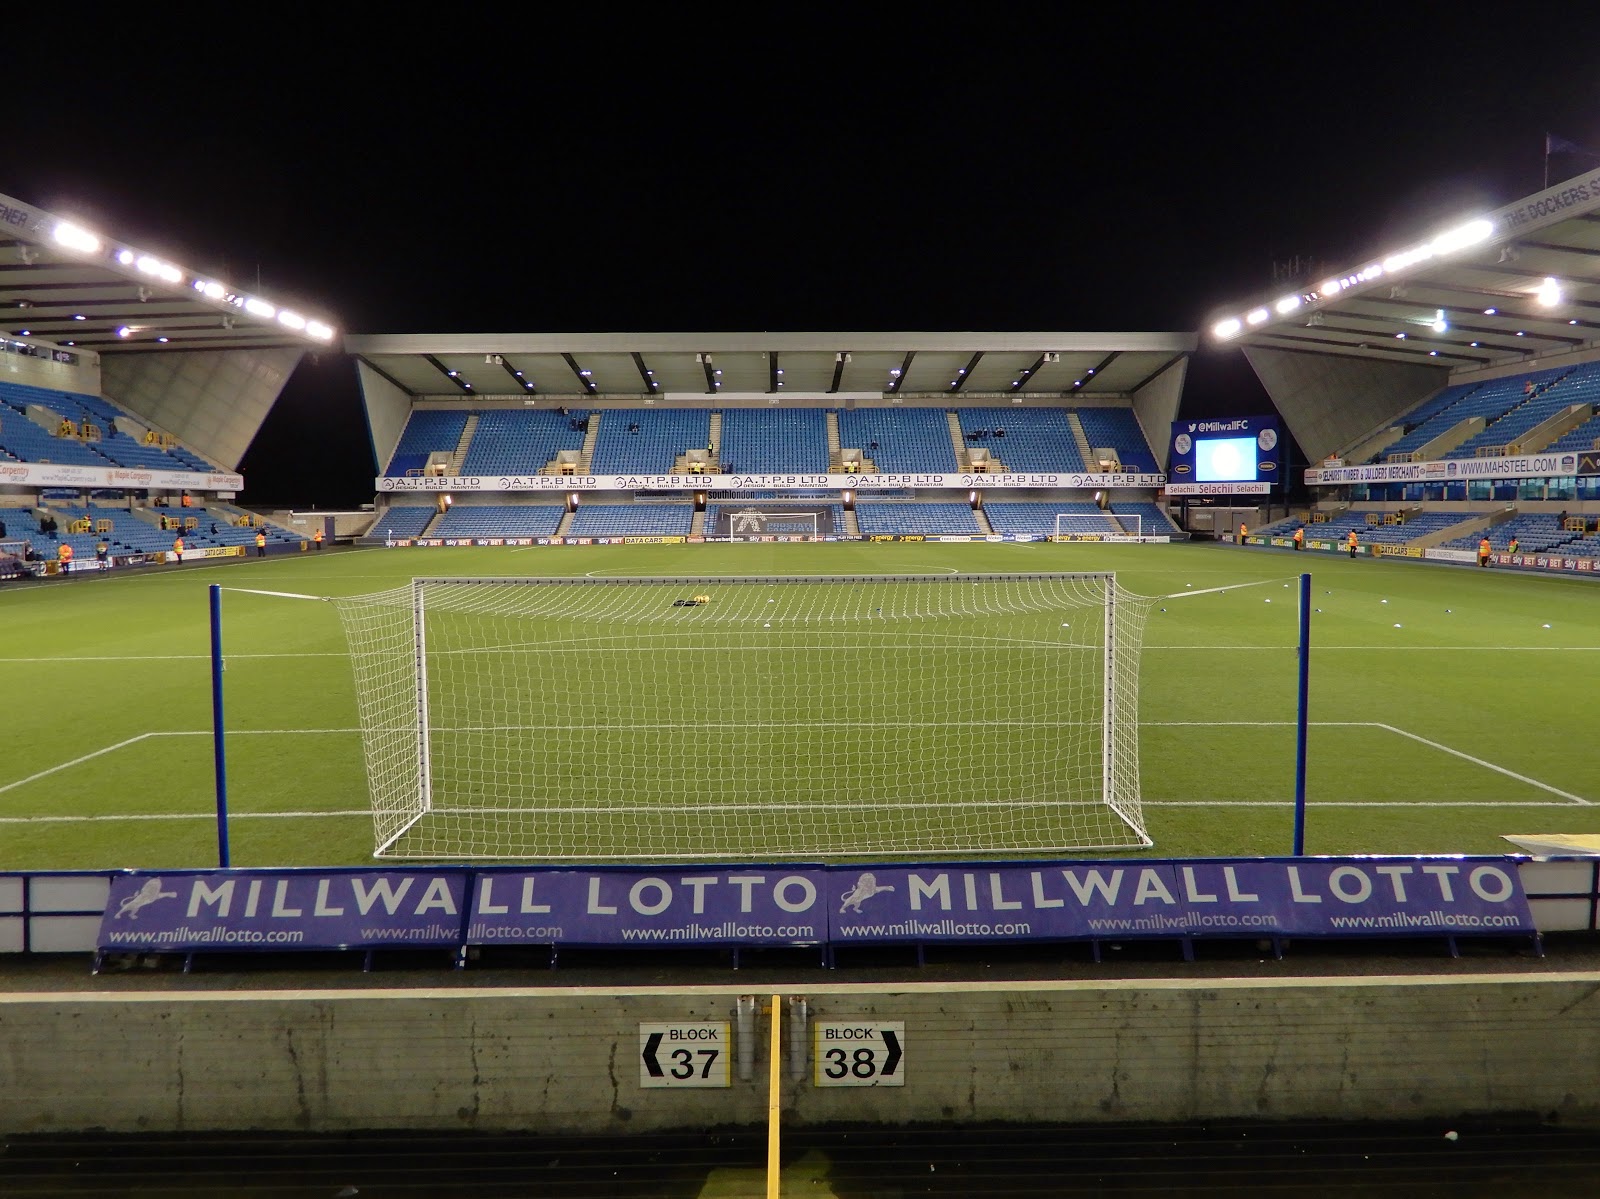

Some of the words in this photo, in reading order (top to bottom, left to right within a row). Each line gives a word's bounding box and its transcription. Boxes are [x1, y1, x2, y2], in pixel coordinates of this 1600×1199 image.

[1527, 184, 1590, 219] DOCKERS
[1198, 420, 1249, 432] @MillwallFC
[1388, 465, 1420, 480] MERCHANTS
[1460, 458, 1557, 475] WWW.MAHSTEEL.COM
[130, 472, 152, 483] Carpentry
[396, 478, 447, 486] A.T.P.B
[453, 478, 480, 486] LTD
[512, 477, 564, 485] A.T.P.B
[569, 477, 596, 485] LTD
[628, 476, 680, 484] A.T.P.B
[685, 476, 712, 484] LTD
[744, 476, 796, 484] A.T.P.B
[801, 476, 828, 484] LTD
[860, 475, 911, 483] A.T.P.B
[916, 475, 943, 483] LTD
[1199, 484, 1233, 493] Selachii
[1236, 484, 1264, 492] Selachii
[1270, 538, 1293, 547] bet365.com
[1306, 540, 1331, 551] bet365.com
[205, 548, 214, 557] DATA
[215, 548, 227, 556] CARS
[1381, 546, 1393, 555] DATA
[1394, 547, 1408, 556] CARS
[1500, 554, 1511, 564] BET
[1512, 554, 1523, 566] sky
[1524, 556, 1535, 566] BET
[1538, 556, 1548, 568] sky
[1550, 557, 1561, 568] BET
[1565, 558, 1576, 570] sky
[1578, 560, 1590, 570] BET
[908, 866, 1259, 911] MILLWALL
[1287, 866, 1513, 904] LOTTO
[186, 877, 551, 918] MILLWALL
[587, 876, 817, 915] LOTTO
[1088, 911, 1278, 930] www.millwalllotto.com
[1330, 911, 1520, 928] www.millwalllotto.com
[622, 922, 814, 940] www.millwalllotto.com
[840, 919, 1031, 937] www.millwalllotto.com
[109, 926, 304, 944] www.millwalllotto.com
[670, 1029, 718, 1040] BLOCK
[825, 1028, 873, 1039] BLOCK
[670, 1049, 719, 1079] 37
[825, 1048, 876, 1078] 38
